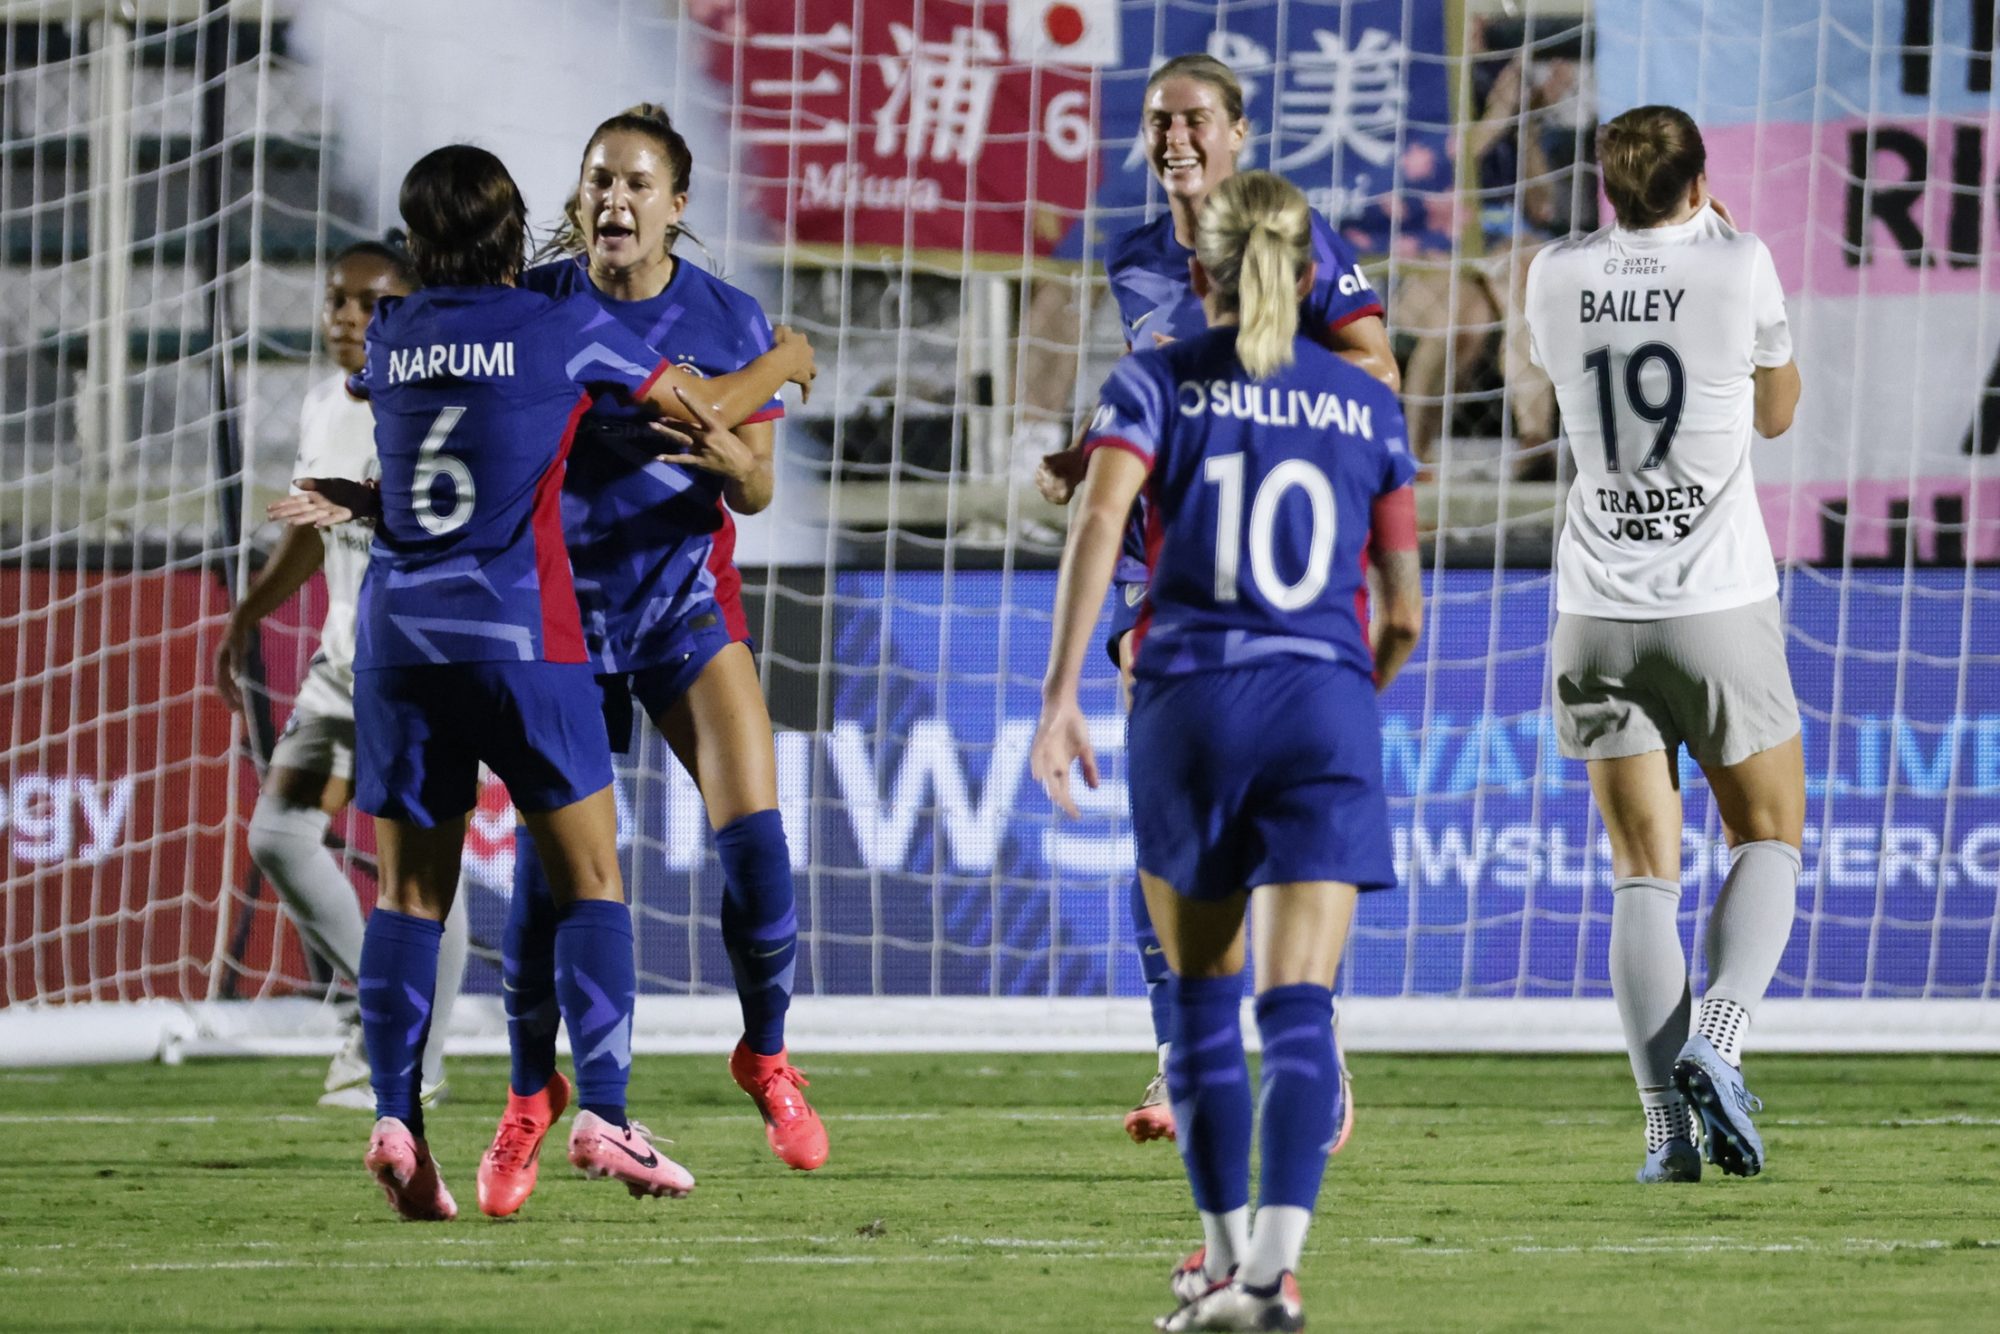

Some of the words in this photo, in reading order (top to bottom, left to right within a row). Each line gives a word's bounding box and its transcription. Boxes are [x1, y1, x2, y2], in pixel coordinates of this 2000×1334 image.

[738, 22, 1003, 165] 三浦
[1044, 90, 1092, 163] 6
[1843, 122, 2000, 268] RI
[1338, 263, 1371, 296] al
[1620, 265, 1667, 276] STREET
[1623, 257, 1659, 268] SIXTH
[1580, 288, 1686, 324] BAILEY
[388, 341, 515, 384] NARUMI
[1178, 379, 1375, 441] O'SULLIVAN
[1582, 340, 1687, 474] 19
[411, 405, 476, 536] 6
[1596, 484, 1706, 515] TRADER
[1203, 450, 1337, 613] 10
[1608, 513, 1691, 541] JOE'S
